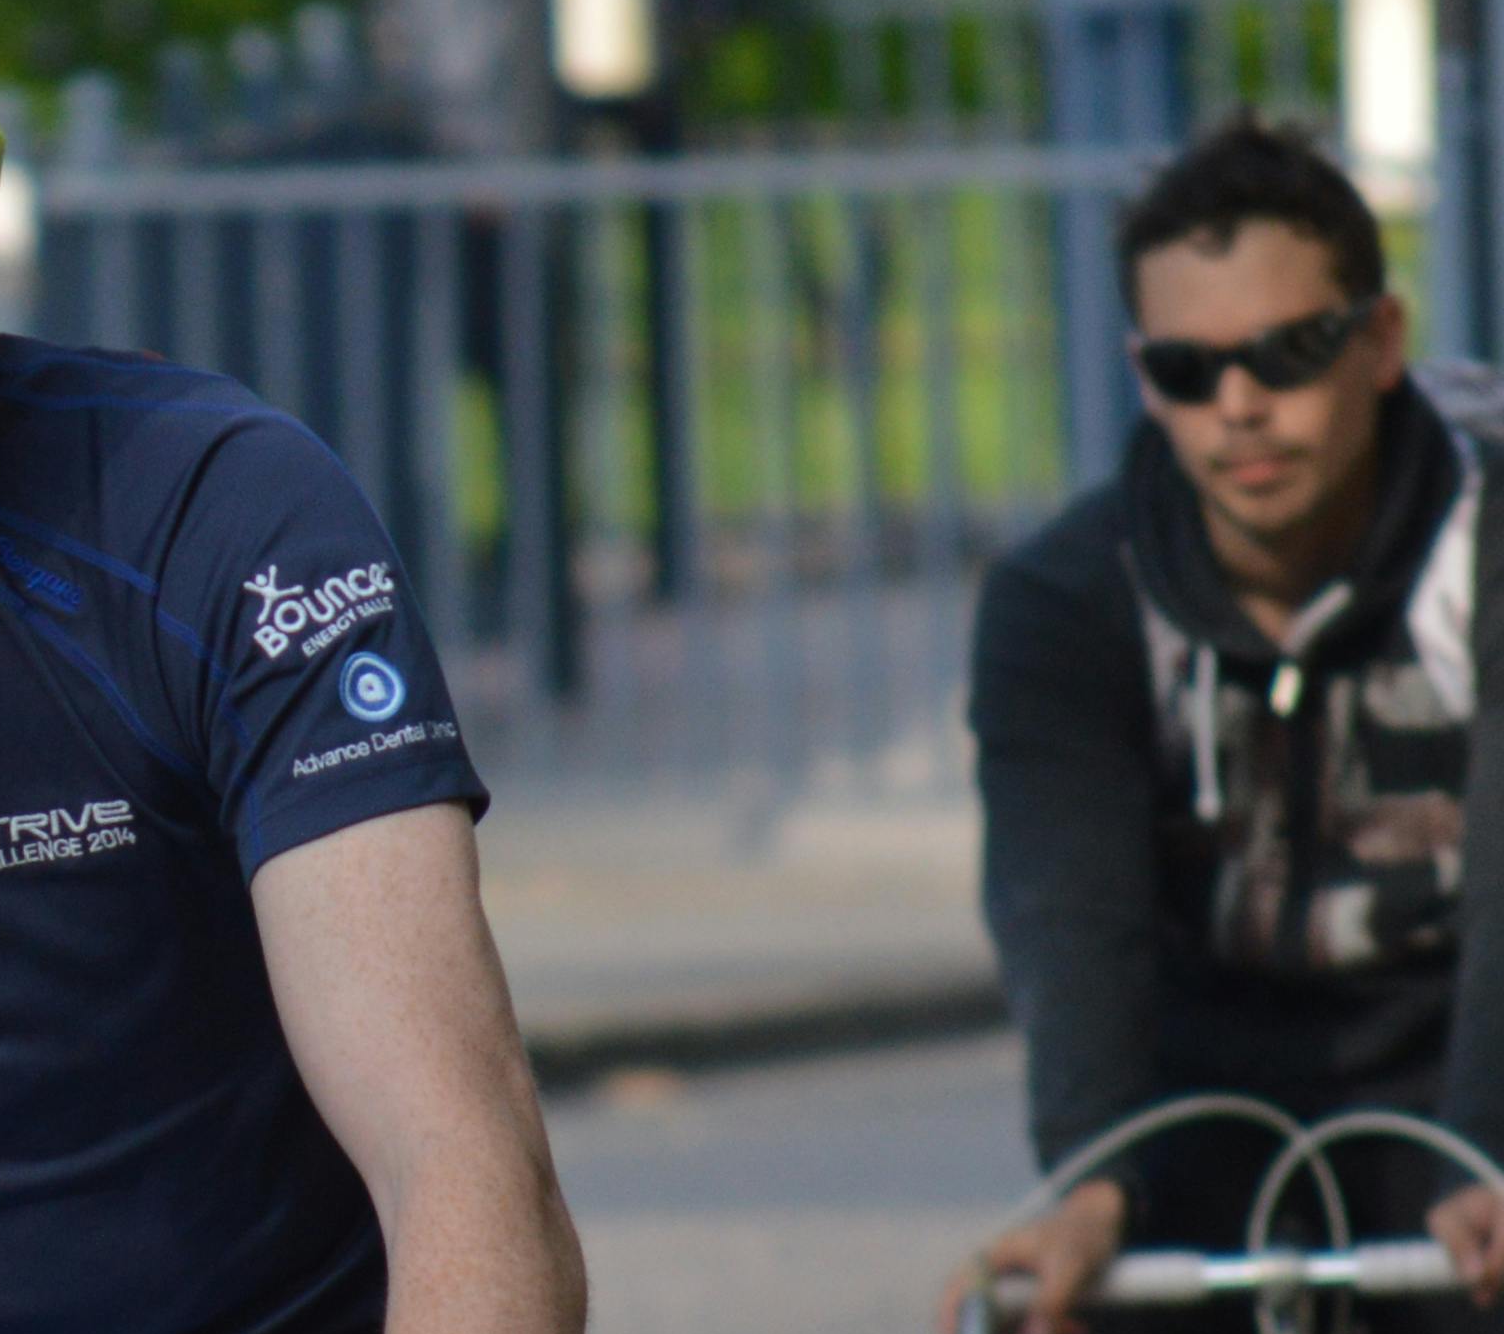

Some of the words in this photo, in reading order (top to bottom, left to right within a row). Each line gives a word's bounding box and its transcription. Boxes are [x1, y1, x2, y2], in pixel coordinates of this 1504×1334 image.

[302, 607, 358, 657] ENERGY
[292, 739, 371, 778] Advance
[371, 722, 426, 752] Dental
[87, 826, 137, 854] 2014
